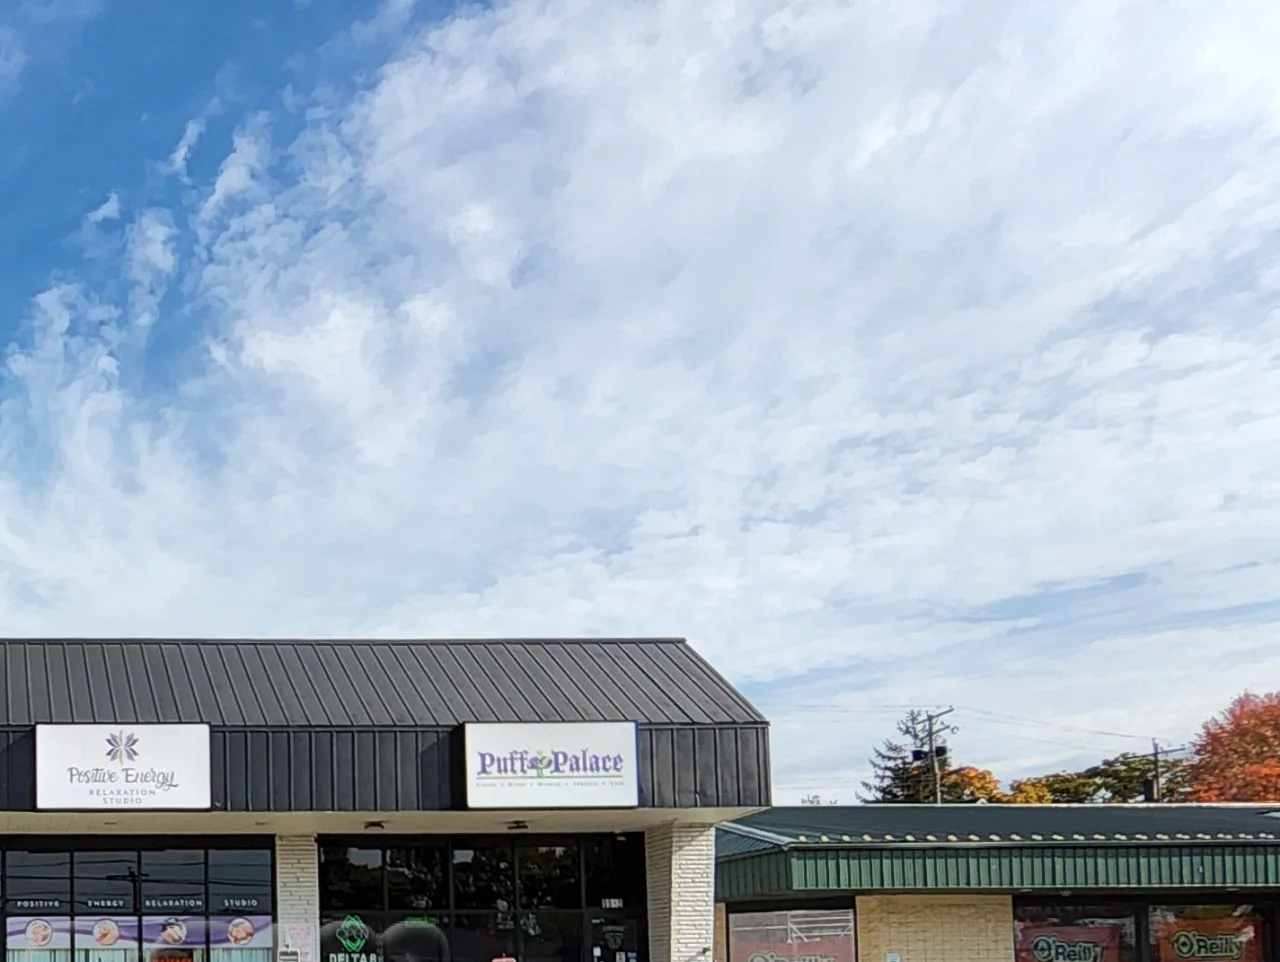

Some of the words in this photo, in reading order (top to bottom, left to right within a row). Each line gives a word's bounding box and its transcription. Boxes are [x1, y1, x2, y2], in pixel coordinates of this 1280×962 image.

[477, 750, 529, 775] Puff
[550, 749, 624, 774] Palace
[67, 767, 119, 784] Positive
[122, 767, 179, 791] Energy
[223, 899, 258, 907] STUDIO
[1173, 930, 1245, 959] O'Reilly
